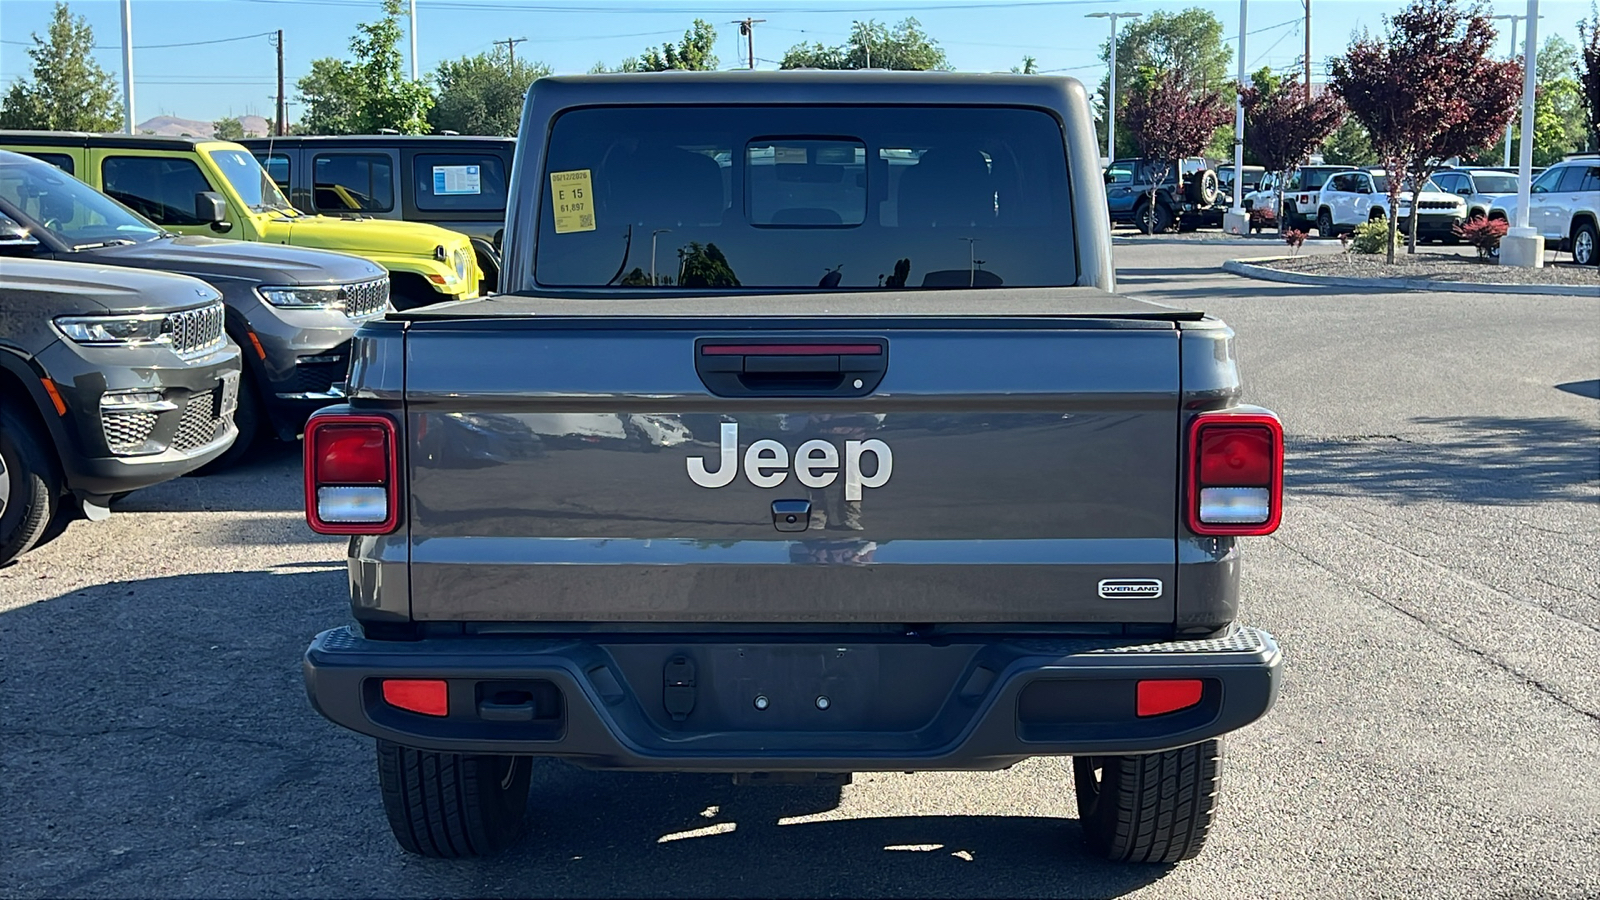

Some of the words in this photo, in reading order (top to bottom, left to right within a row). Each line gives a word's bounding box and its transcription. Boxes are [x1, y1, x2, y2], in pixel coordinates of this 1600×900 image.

[559, 190, 565, 200] E
[572, 189, 583, 199] 15
[560, 203, 584, 213] 61,897
[686, 422, 893, 501] Jeep
